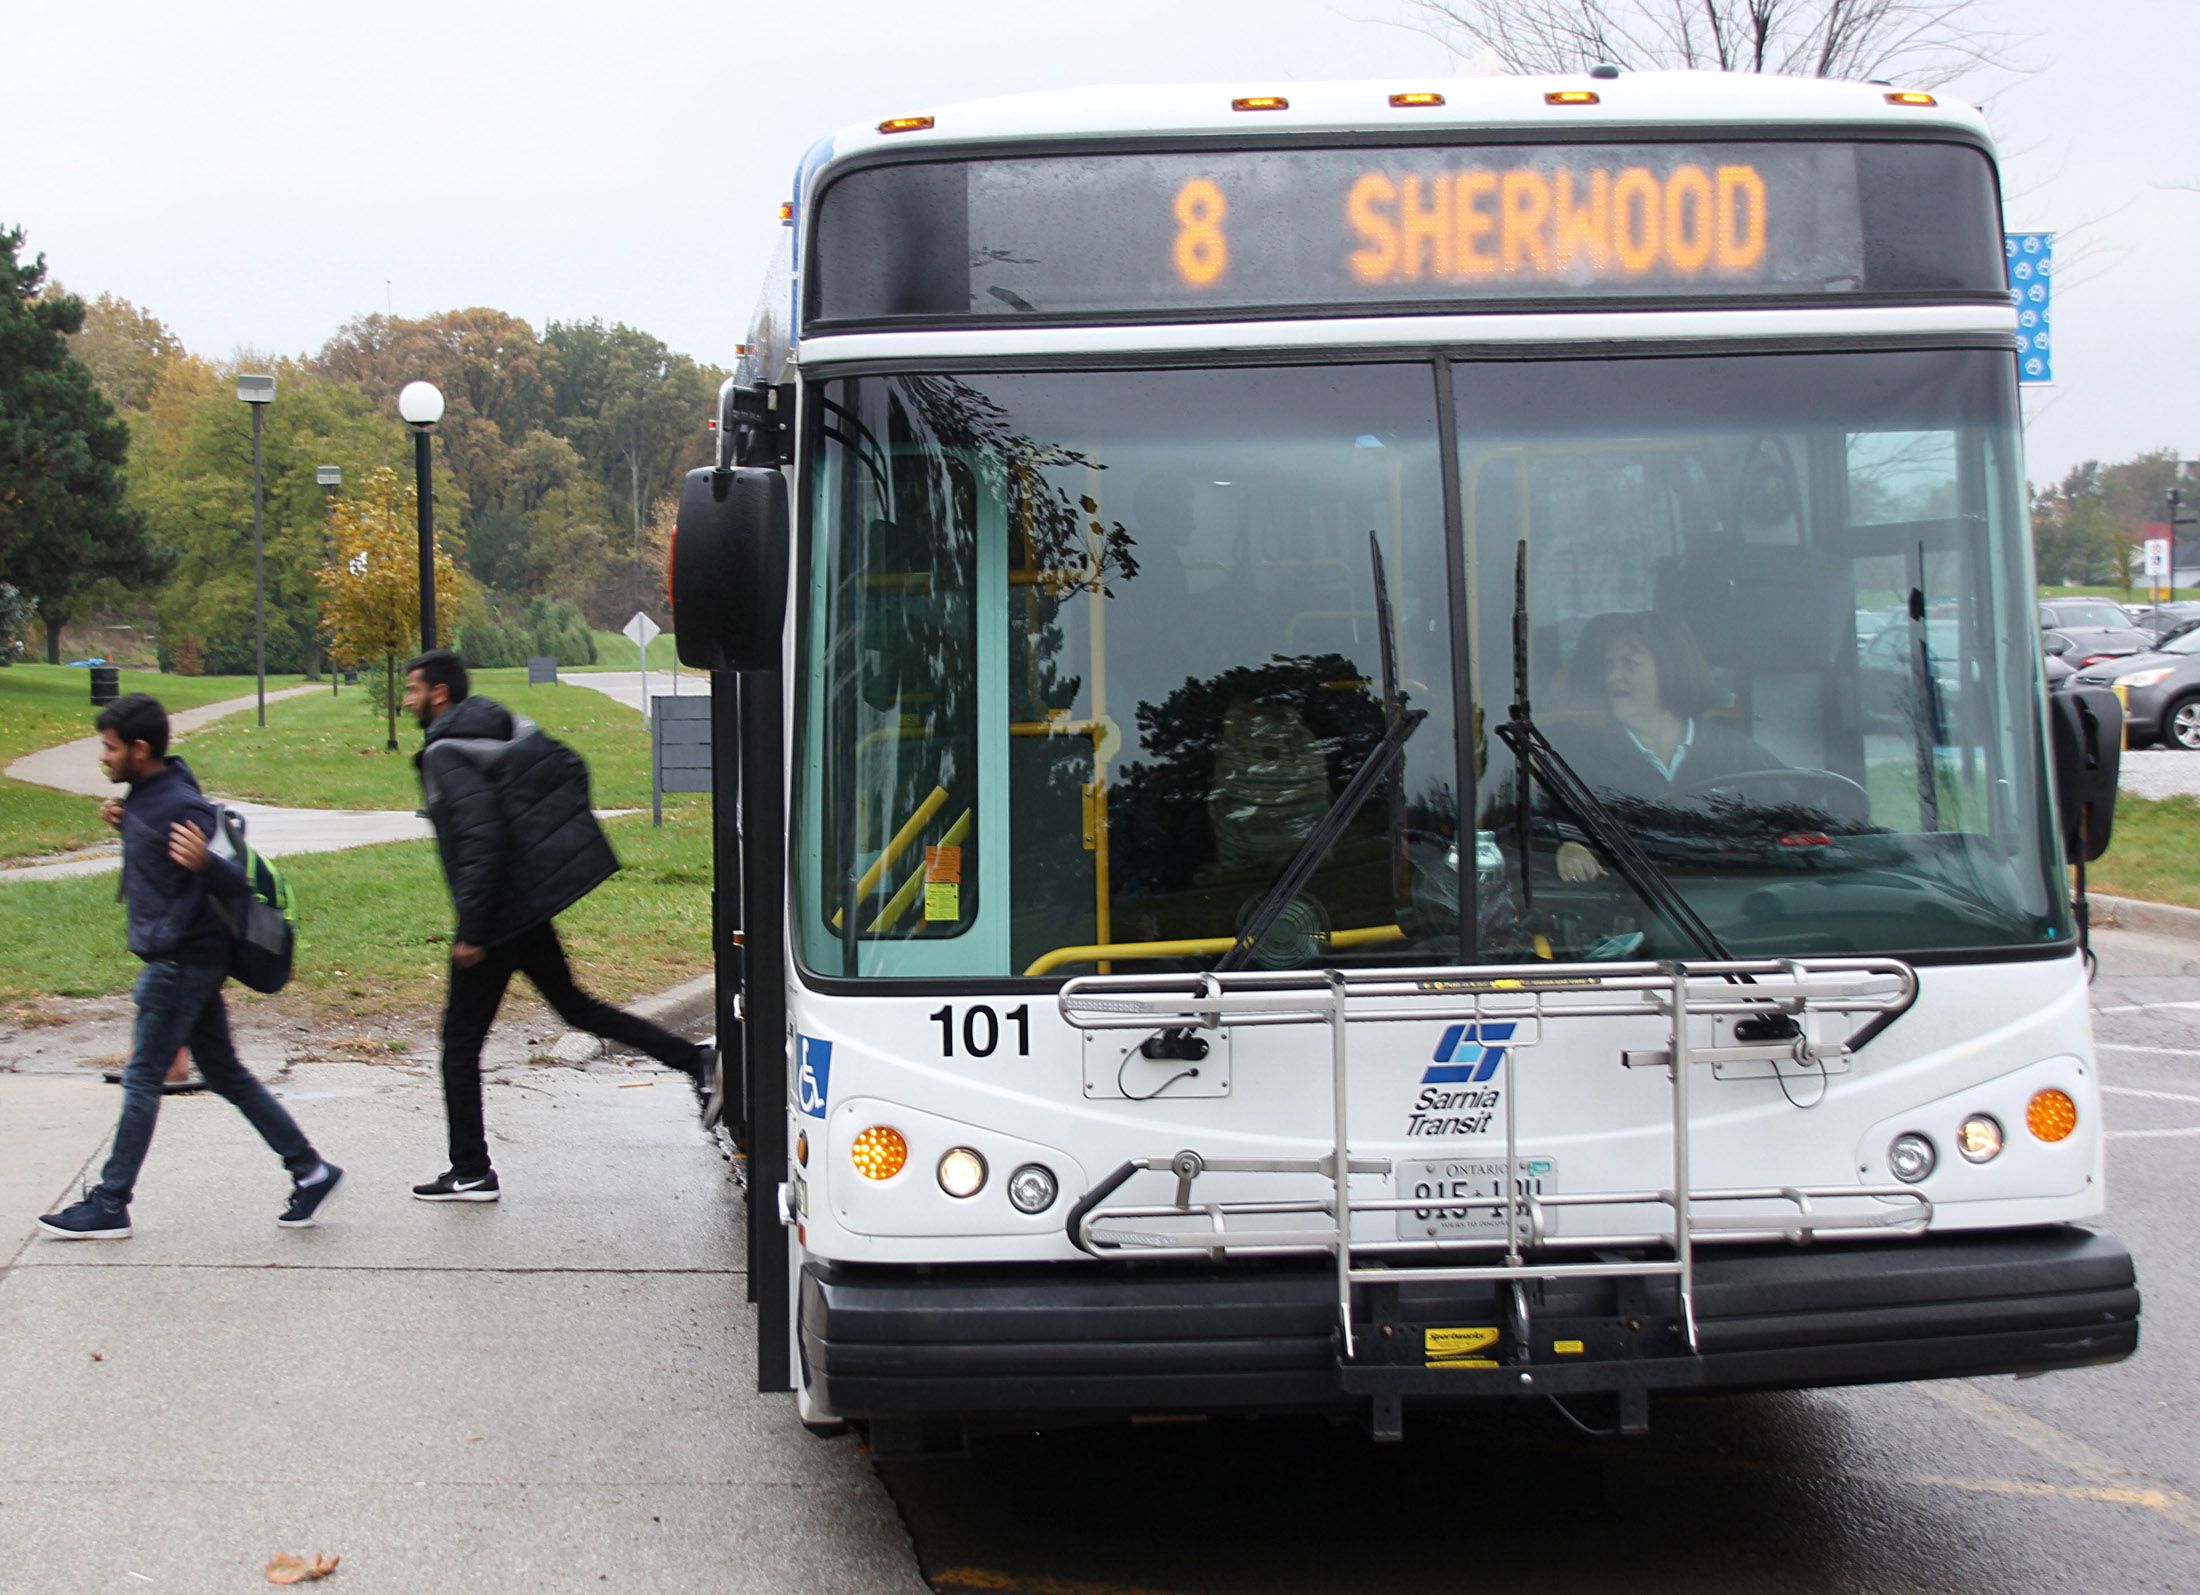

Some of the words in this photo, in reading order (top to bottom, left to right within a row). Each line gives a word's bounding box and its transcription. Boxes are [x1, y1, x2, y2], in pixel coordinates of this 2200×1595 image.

[1174, 178, 1226, 285] 8
[1348, 165, 1766, 281] SHERWOOD
[929, 1003, 1030, 1058] 101
[1414, 1085, 1500, 1111] Sarnia
[1406, 1110, 1493, 1137] Transit
